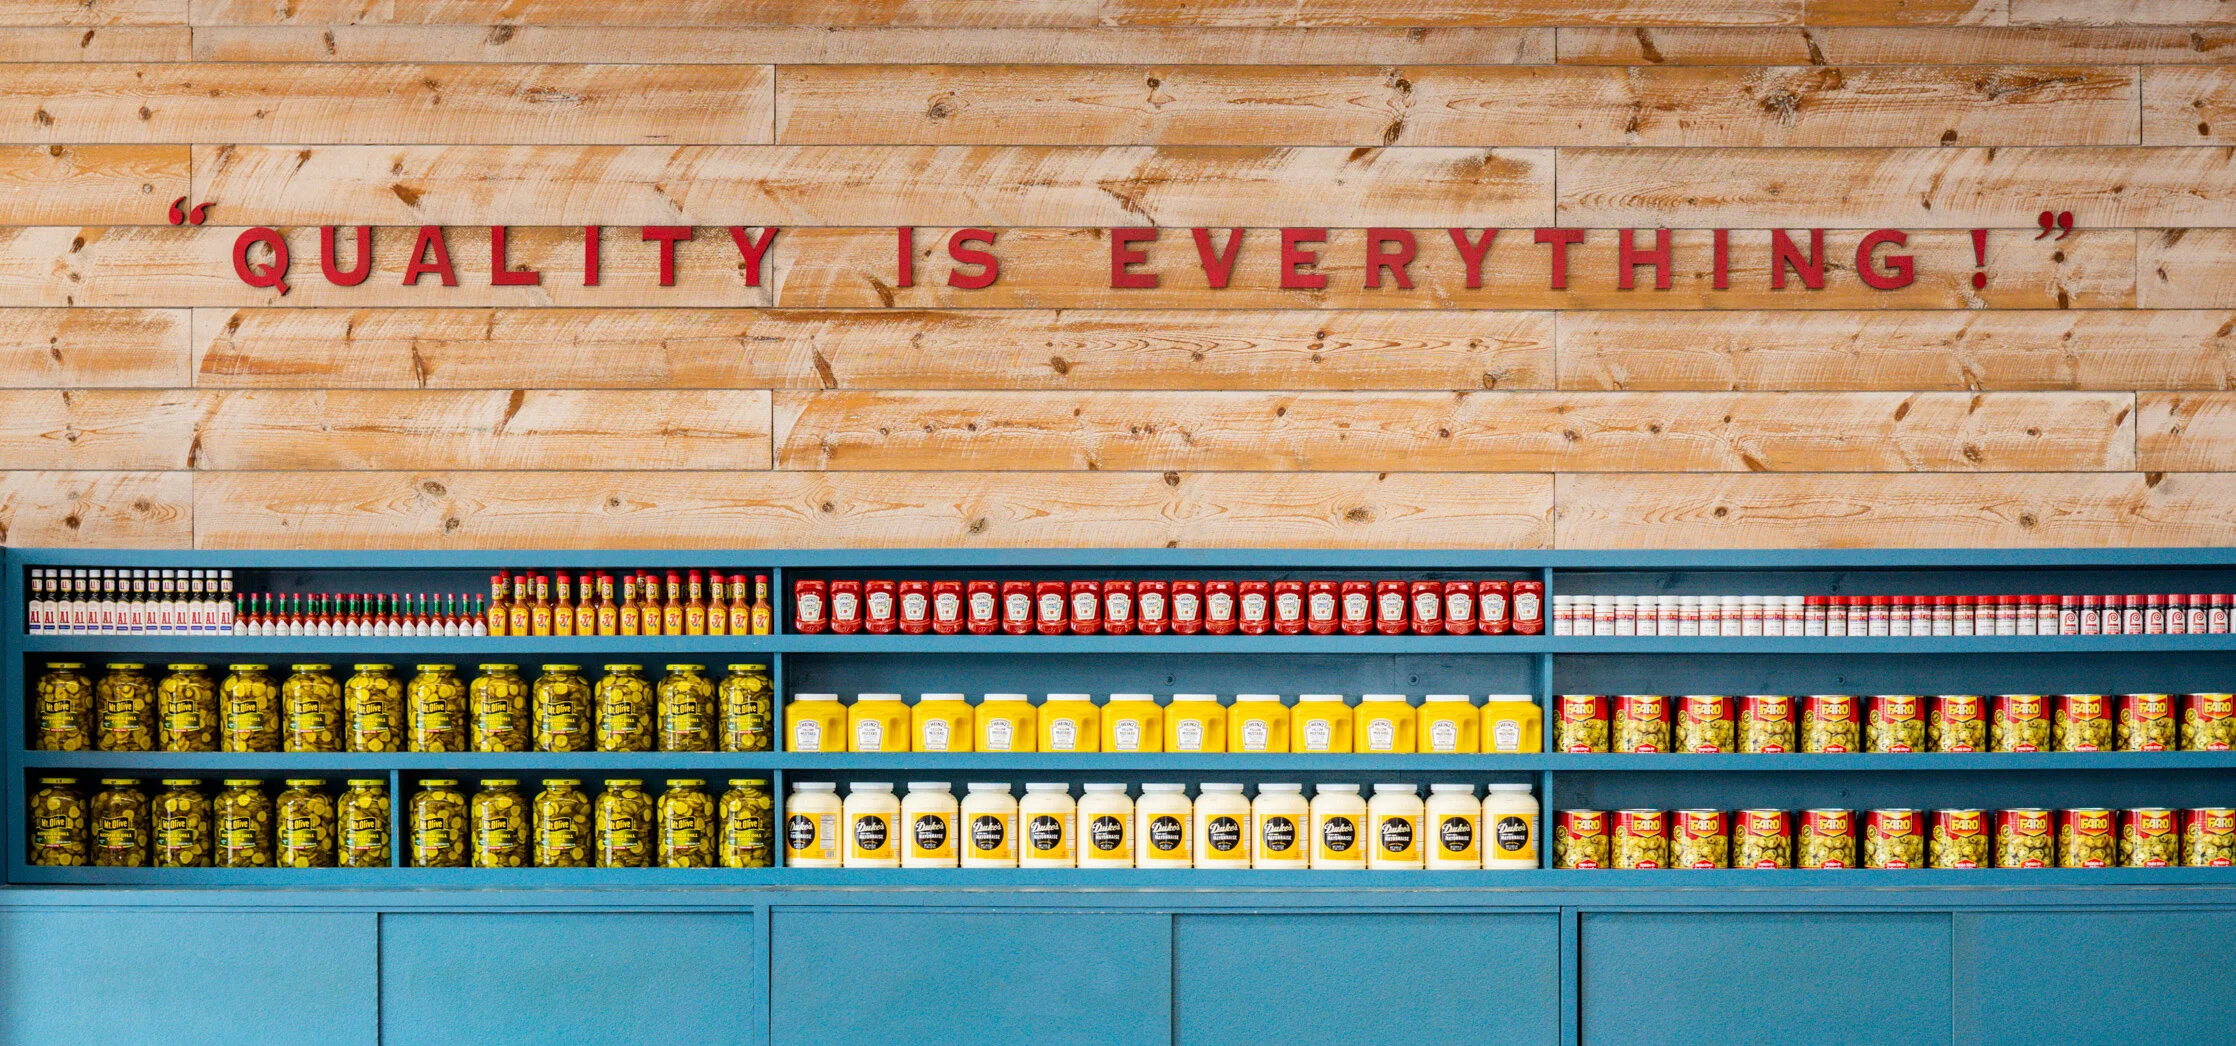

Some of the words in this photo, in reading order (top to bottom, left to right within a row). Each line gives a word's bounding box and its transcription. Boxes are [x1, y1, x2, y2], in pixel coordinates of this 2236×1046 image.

[896, 227, 1000, 290] IS
[492, 614, 504, 625] 57
[514, 614, 525, 625] 57
[537, 614, 548, 625] 57
[558, 614, 570, 625] 57
[580, 614, 592, 625] 57
[602, 614, 614, 625] 57
[624, 614, 635, 625] 57
[648, 614, 658, 625] 57
[668, 614, 680, 625] 57
[691, 614, 702, 625] 57
[712, 614, 723, 625] 57
[734, 614, 746, 625] 57
[757, 614, 768, 625] 57
[54, 701, 69, 711] Olive
[117, 701, 132, 711] Olive
[178, 701, 193, 712] Olive
[241, 702, 256, 712] Olive
[303, 702, 318, 712] Olive
[367, 703, 382, 713] Olive
[430, 702, 445, 712] Olive
[492, 701, 507, 712] Olive
[556, 703, 571, 713] Olive
[616, 703, 630, 713] Olive
[680, 703, 695, 713] Olive
[742, 703, 757, 713] Olive
[1566, 704, 1593, 715] FARO
[1632, 704, 1660, 715] FARO
[1694, 704, 1721, 715] FARO
[1760, 704, 1785, 715] FARO
[1822, 705, 1849, 715] FARO
[1887, 705, 1914, 715] FARO
[1948, 705, 1975, 715] FARO
[2012, 703, 2039, 714] FARO
[2072, 703, 2100, 714] FARO
[2139, 703, 2166, 713] FARO
[2205, 702, 2231, 713] FARO
[50, 816, 65, 827] Olive
[112, 818, 127, 828] Olive
[171, 818, 186, 828] Olive
[234, 818, 248, 828] Olive
[295, 818, 310, 828] Olive
[360, 818, 375, 828] Olive
[428, 818, 443, 828] Olive
[492, 818, 507, 828] Olive
[555, 818, 570, 828] Olive
[617, 818, 631, 828] Olive
[679, 818, 694, 828] Olive
[743, 818, 757, 828] Olive
[916, 821, 944, 832] Duke's
[1574, 820, 1600, 831] FARO
[1633, 820, 1660, 831] FARO
[1690, 820, 1717, 831] FARO
[1753, 820, 1779, 831] FARO
[1819, 820, 1846, 830] FARO
[1883, 820, 1910, 830] FARO
[1952, 820, 1978, 830] FARO
[2020, 819, 2046, 829] FARO
[2080, 818, 2107, 829] FARO
[2142, 818, 2169, 829] FARO
[2207, 818, 2234, 828] FARO
[856, 822, 884, 832] Duke's
[973, 822, 1002, 832] Duke's
[1031, 822, 1059, 832] Duke's
[1092, 822, 1121, 832] Duke's
[1152, 822, 1180, 833] Duke's
[1210, 822, 1238, 833] Duke's
[1264, 823, 1293, 833] Duke's
[1324, 823, 1353, 833] Duke's
[1382, 823, 1411, 834] Duke's
[1442, 823, 1469, 833] Duke's
[1497, 823, 1526, 833] Duke's
